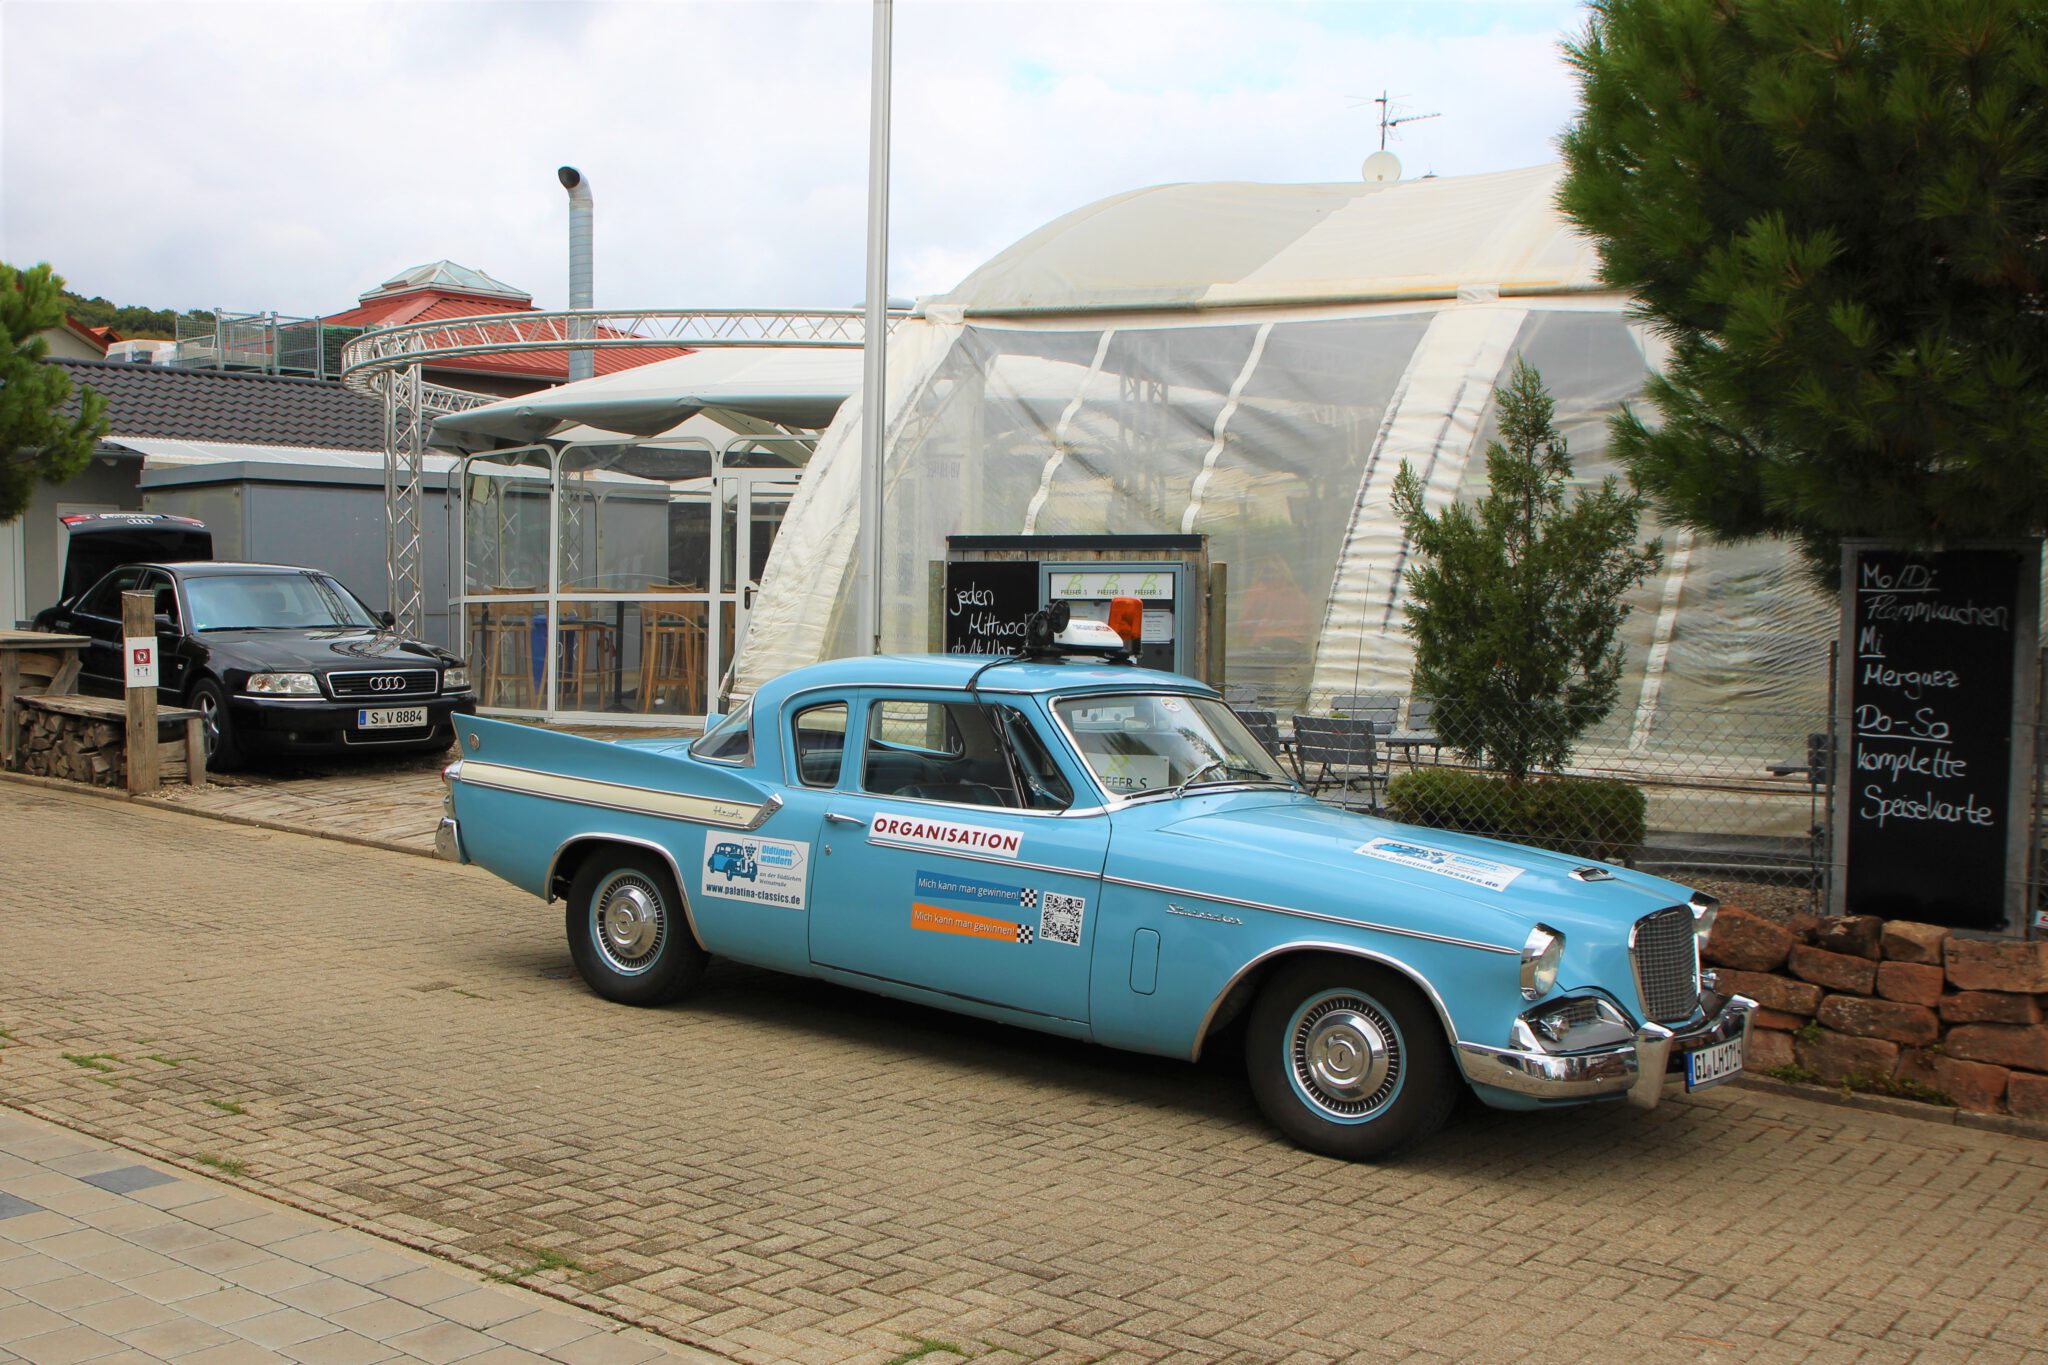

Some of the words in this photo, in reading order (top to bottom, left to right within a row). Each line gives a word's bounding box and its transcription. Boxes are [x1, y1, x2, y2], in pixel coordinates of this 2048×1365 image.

[950, 581, 994, 616] jeden
[951, 637, 966, 654] ab
[1859, 625, 1883, 655] Mi
[1863, 664, 1960, 700] Merguez
[371, 712, 379, 724] S
[396, 710, 422, 723] 8884
[1857, 742, 1967, 783] komplette
[1861, 785, 1994, 828] Speisekarte
[874, 818, 1018, 851] ORGANISATION
[706, 884, 801, 905] www.palatina-classics.de
[918, 878, 937, 889] Mich
[938, 881, 957, 891] kann
[959, 884, 977, 894] man
[978, 887, 1019, 900] gewinnen!
[914, 911, 933, 922] Mich
[934, 915, 953, 925] kann
[955, 919, 973, 928] man
[974, 922, 1015, 936] gewinnen!
